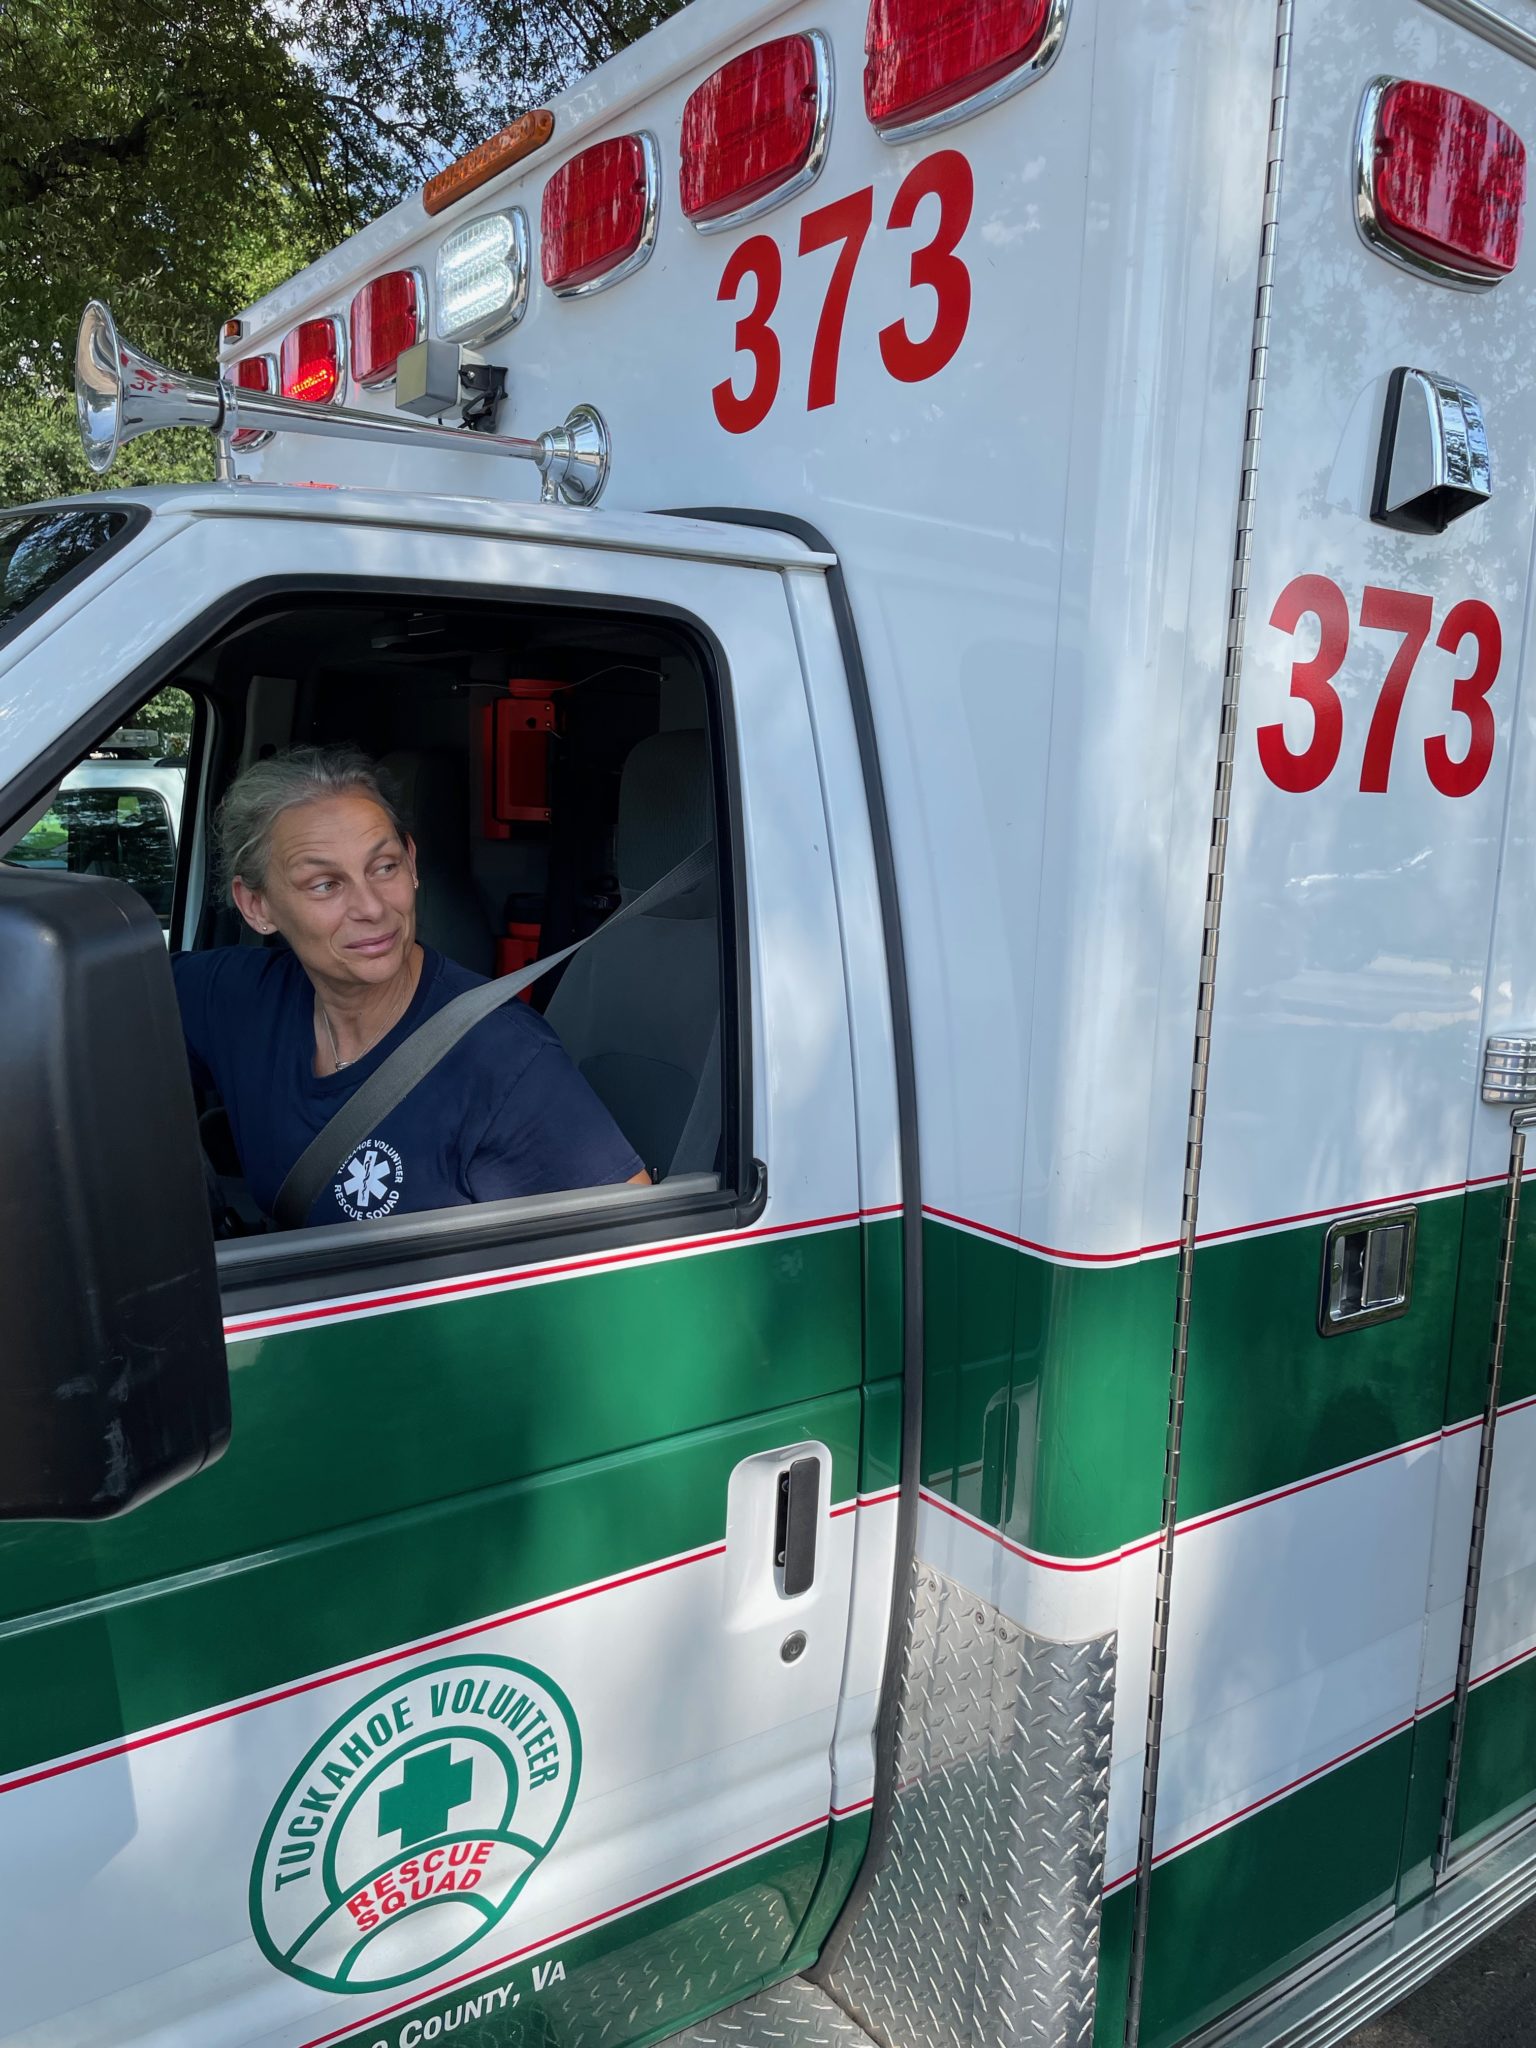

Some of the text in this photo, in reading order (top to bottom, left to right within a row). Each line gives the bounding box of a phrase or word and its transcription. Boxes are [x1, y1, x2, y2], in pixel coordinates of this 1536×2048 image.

[712, 149, 975, 434] 373
[1257, 573, 1502, 798] 373
[374, 1140, 403, 1184] VOLUNTEER
[334, 1184, 400, 1221] RESCUE SQUAD
[275, 1678, 560, 1892] TUCKAHOE VOLUNTEER
[346, 1841, 495, 1918] RESCUE
[356, 1868, 482, 1932] SQUAD
